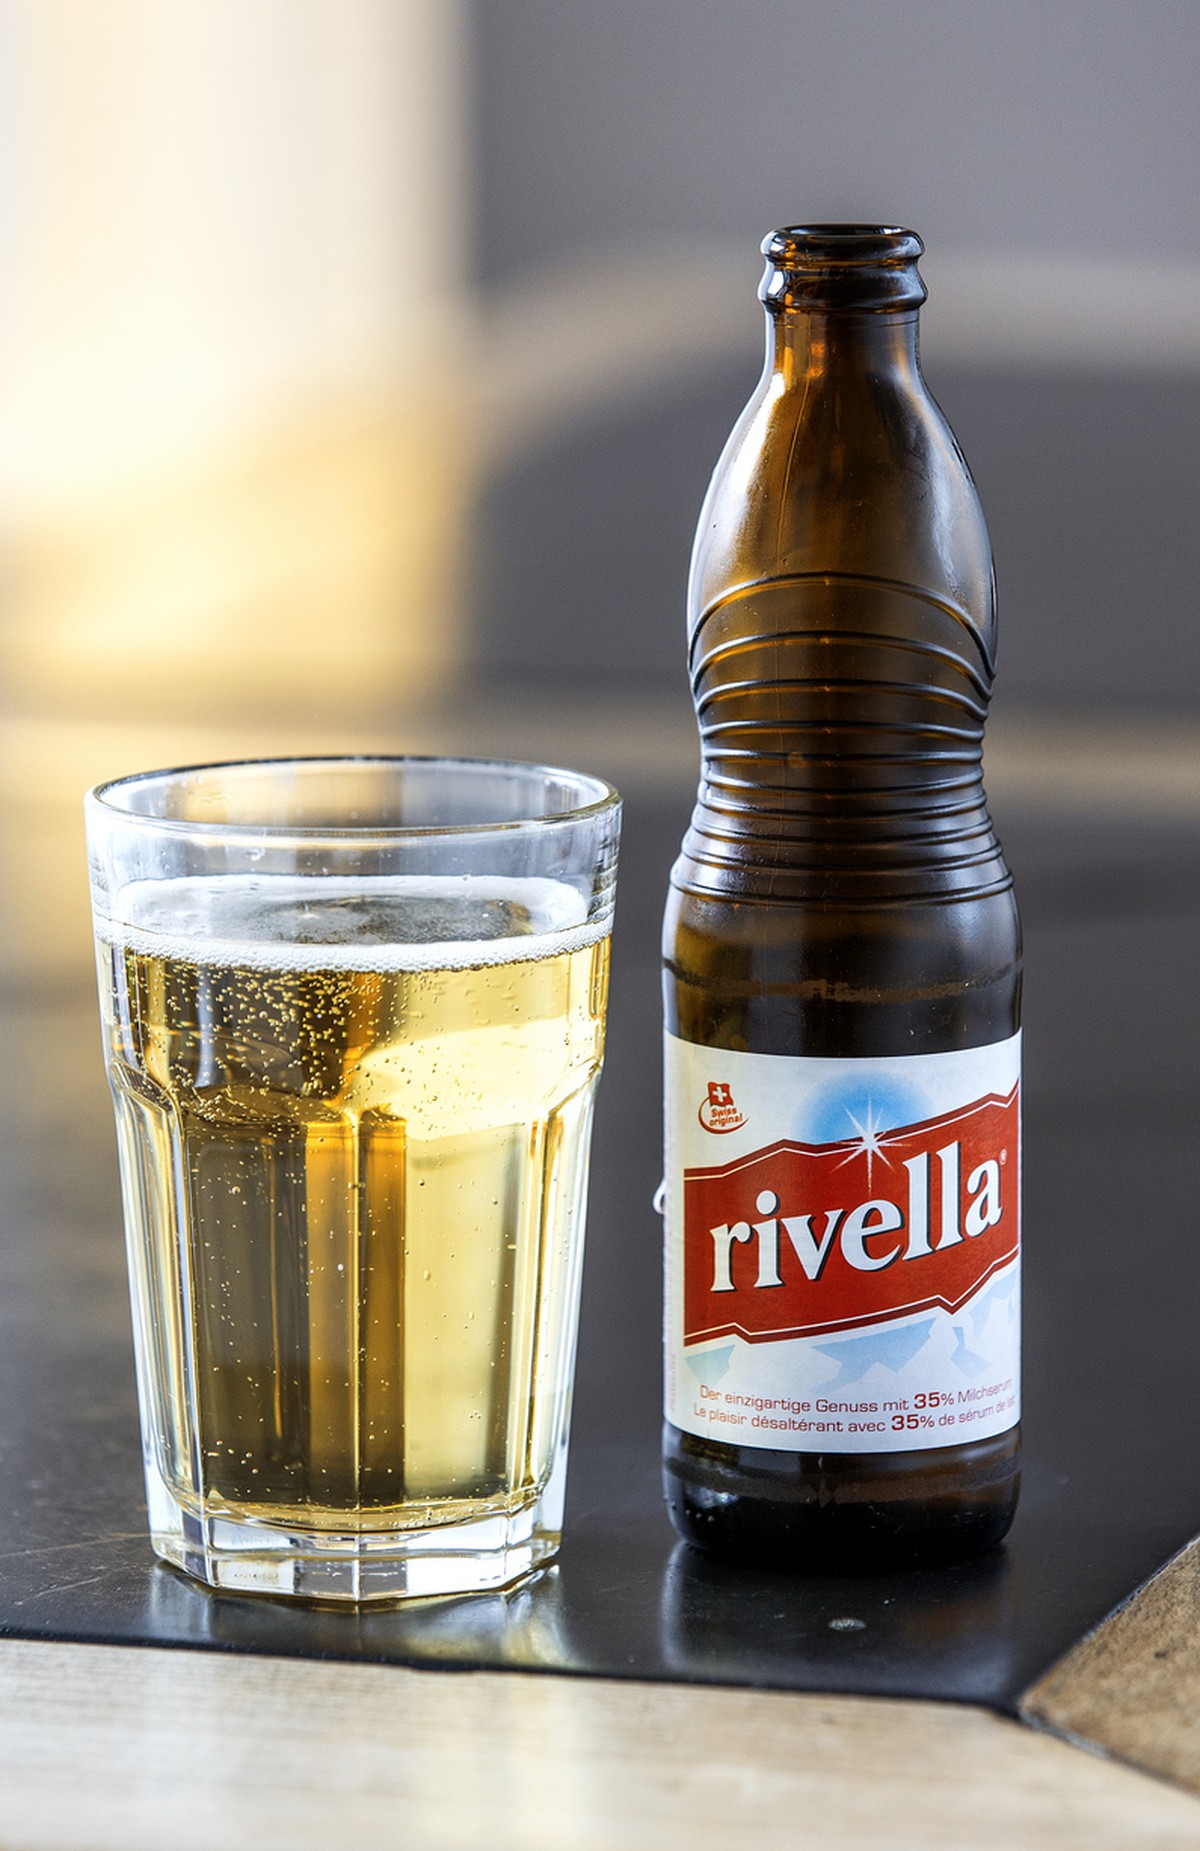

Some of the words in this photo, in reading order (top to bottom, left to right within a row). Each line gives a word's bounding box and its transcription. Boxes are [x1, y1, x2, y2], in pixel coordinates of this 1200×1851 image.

[709, 1112, 743, 1127] original
[711, 1107, 737, 1117] Swiss
[710, 1141, 1002, 1293] rivella
[700, 1384, 721, 1400] Der
[725, 1392, 811, 1414] einzigartige
[816, 1399, 878, 1413] Genuss
[883, 1397, 909, 1411] mit
[914, 1391, 954, 1409] 35%
[693, 1402, 707, 1417] Le
[709, 1409, 747, 1425] plaisir
[751, 1415, 843, 1432] désaltérant
[848, 1421, 886, 1432] avec
[891, 1414, 935, 1431] 35%
[938, 1413, 955, 1426] de
[958, 1406, 994, 1423] sérum
